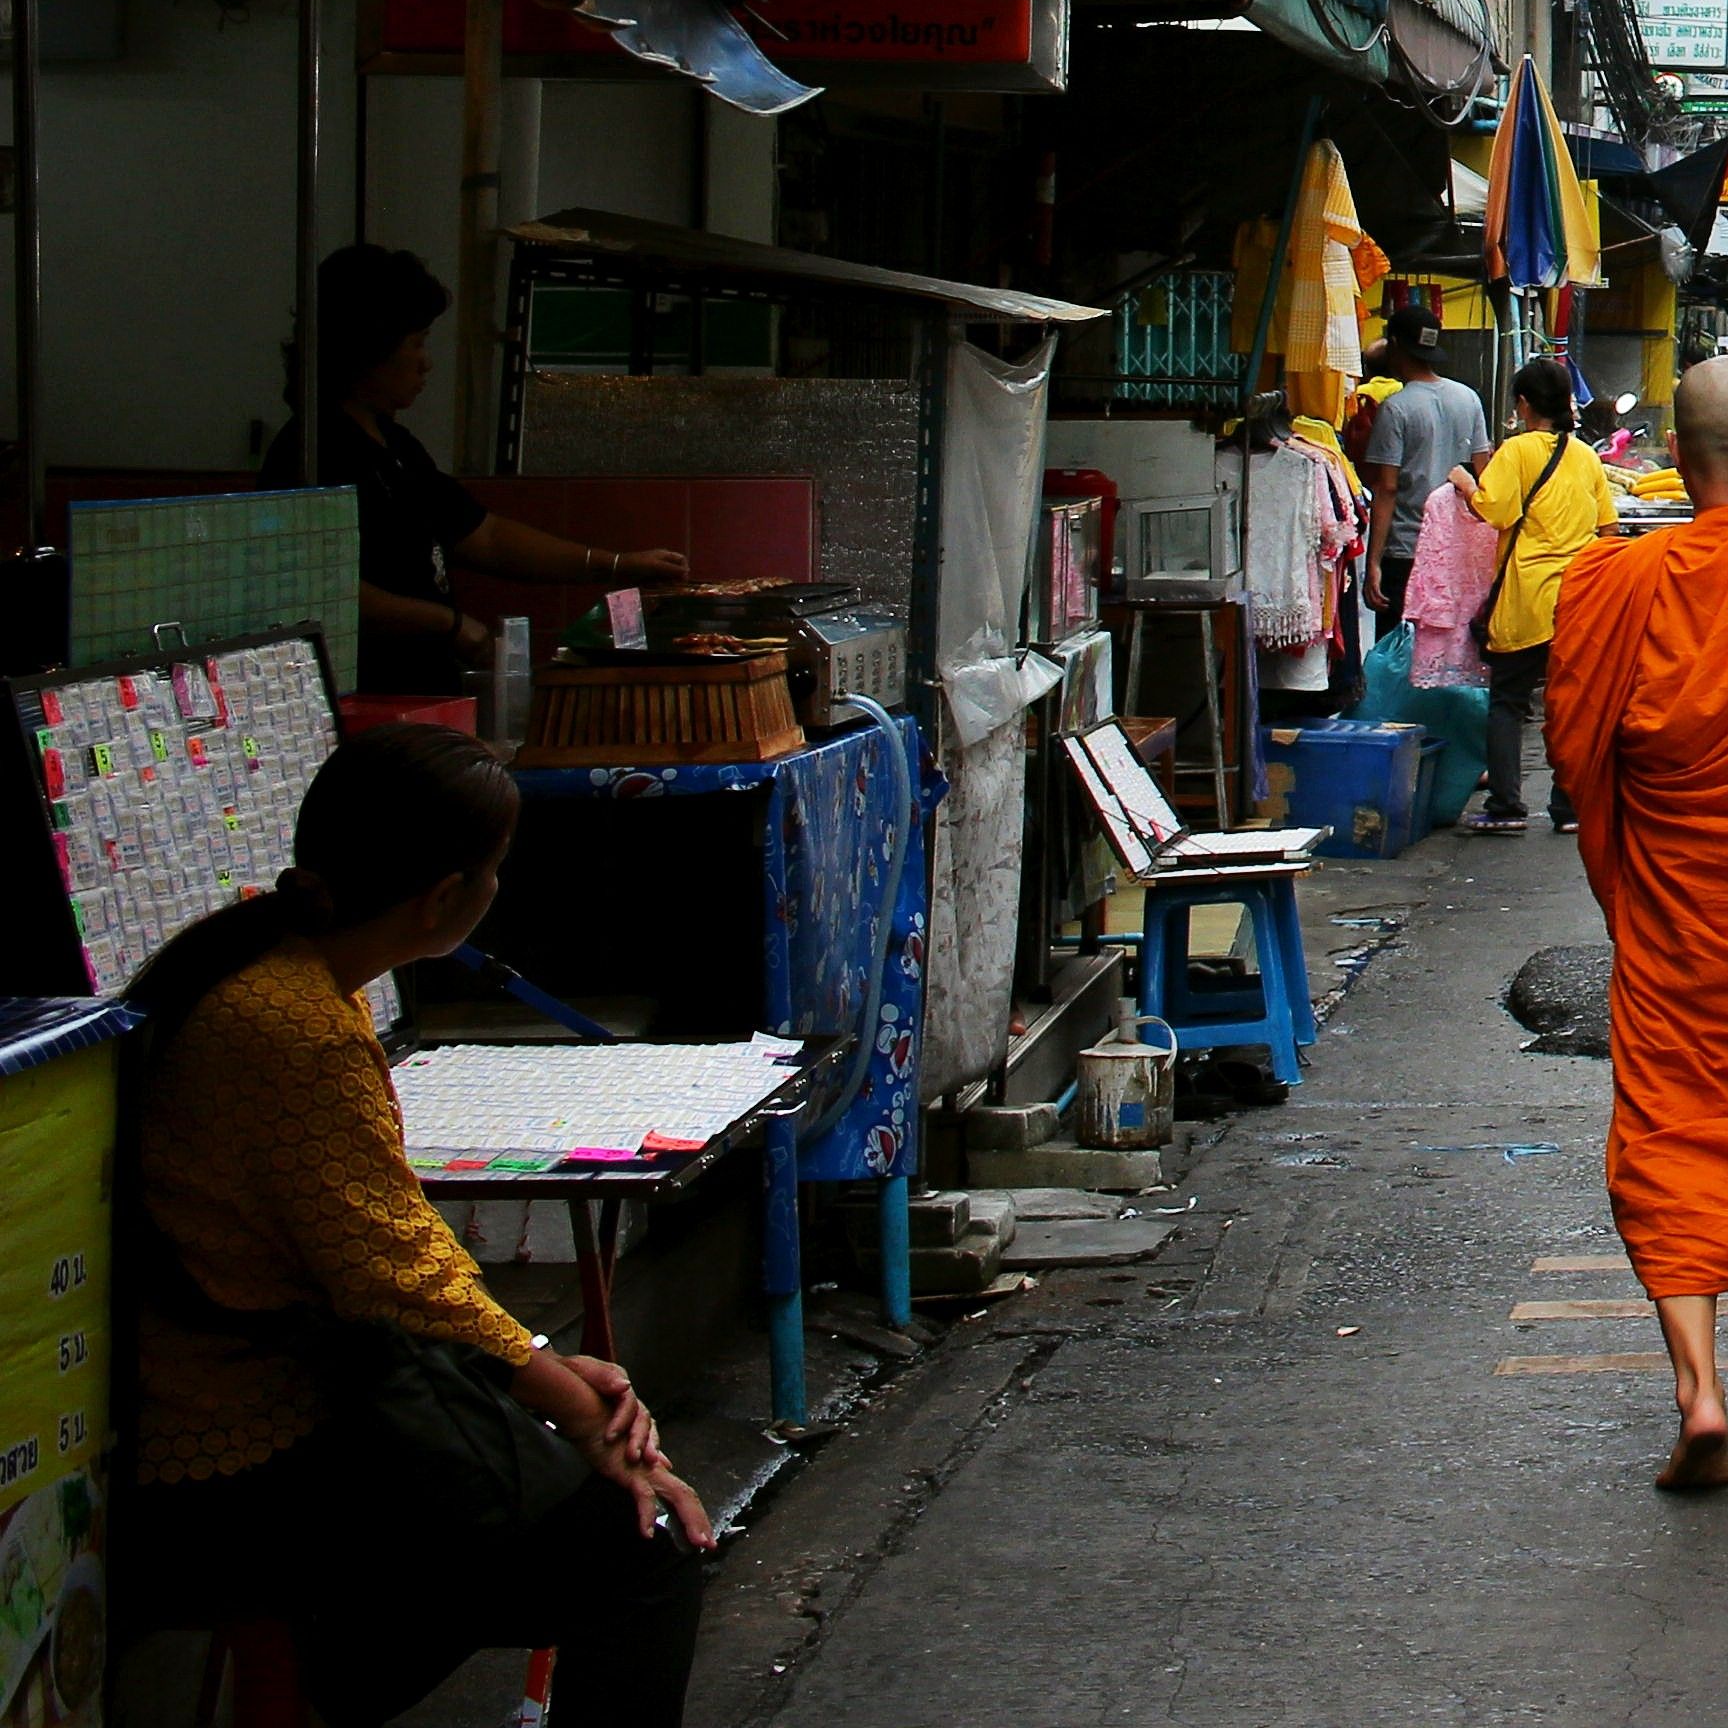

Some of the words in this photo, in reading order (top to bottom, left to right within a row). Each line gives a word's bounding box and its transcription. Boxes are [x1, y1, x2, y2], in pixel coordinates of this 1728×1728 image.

[51, 1258, 69, 1295] 40
[60, 1337, 70, 1370] 5
[59, 1417, 70, 1451] 5
